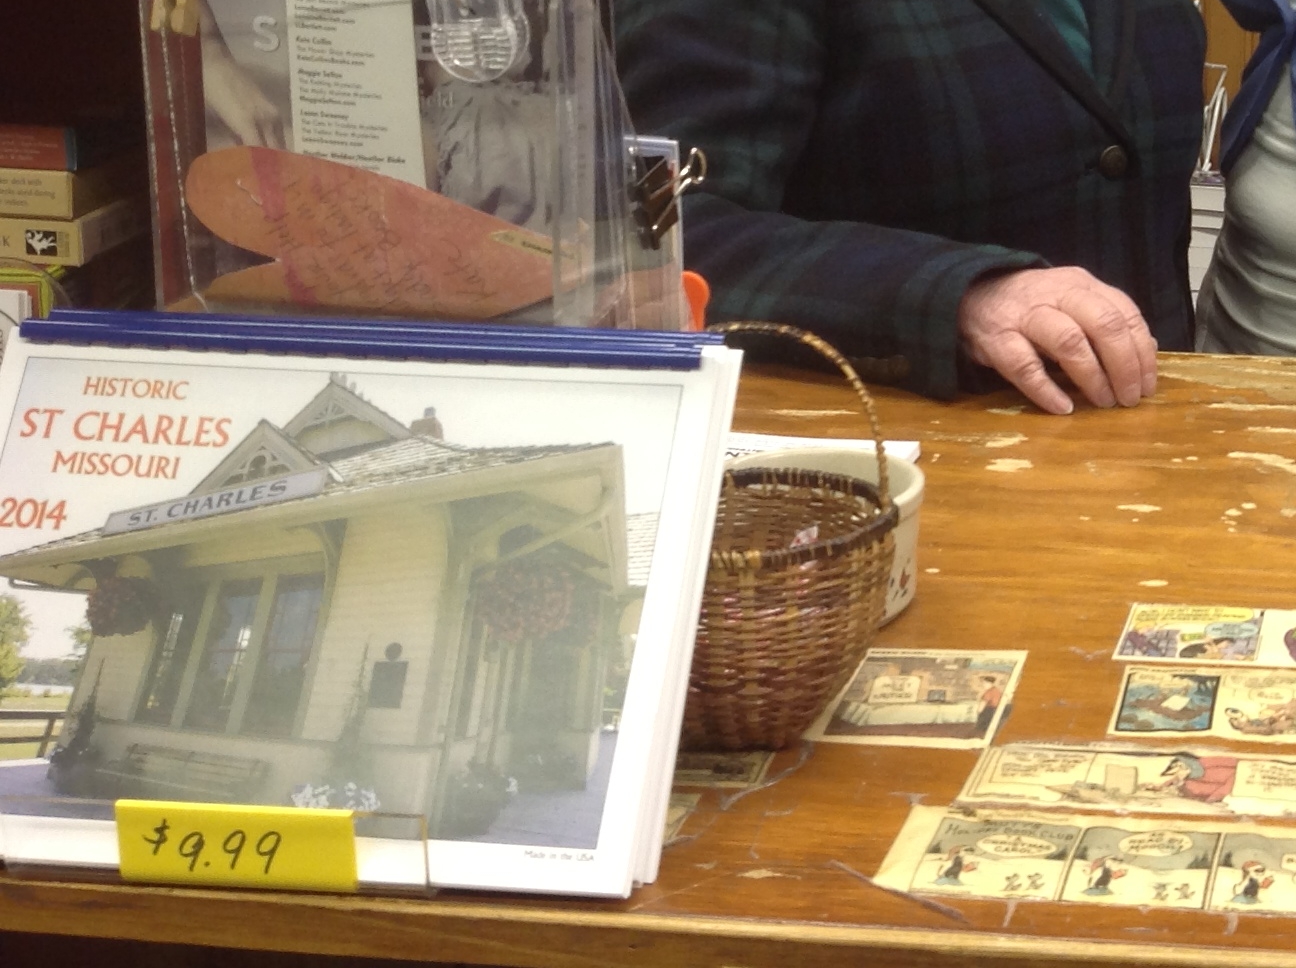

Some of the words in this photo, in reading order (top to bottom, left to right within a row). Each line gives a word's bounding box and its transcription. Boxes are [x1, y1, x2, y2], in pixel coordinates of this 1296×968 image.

[83, 375, 190, 401] HISTORIC
[20, 408, 62, 439] ST
[73, 410, 232, 448] CHARLES
[51, 450, 180, 480] MISSOURI
[0, 497, 67, 530] 2014
[127, 507, 160, 528] ST.
[166, 480, 288, 519] CHARLES
[143, 820, 284, 874] $9.99
[524, 849, 546, 860] Made
[560, 851, 573, 860] the
[576, 852, 595, 862] USA
